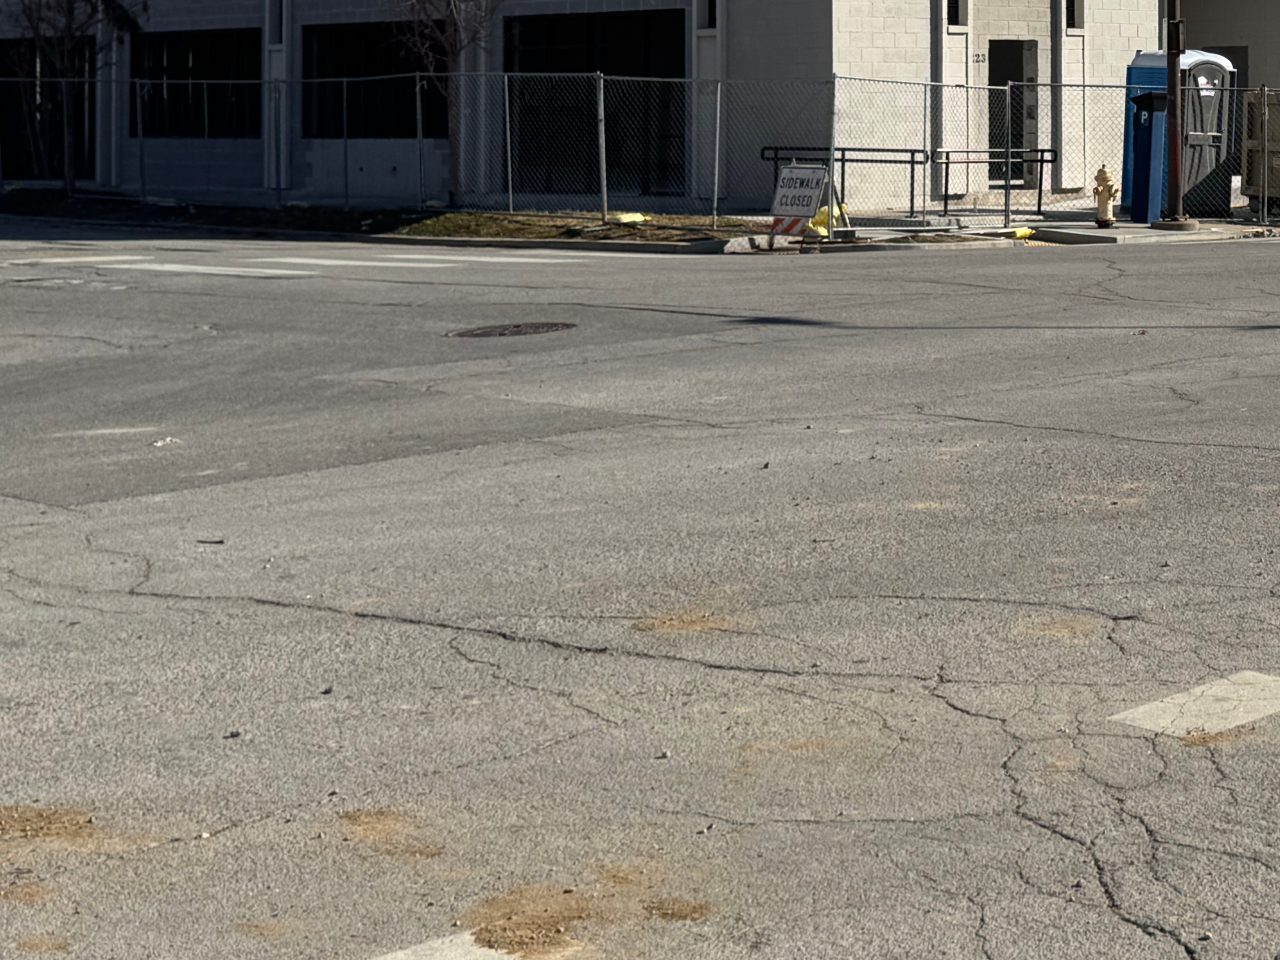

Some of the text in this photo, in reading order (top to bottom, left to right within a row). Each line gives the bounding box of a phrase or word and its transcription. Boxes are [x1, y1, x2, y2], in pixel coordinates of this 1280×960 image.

[1141, 111, 1149, 124] P
[780, 177, 822, 190] SIDEWALK
[780, 195, 813, 208] CLOSED
